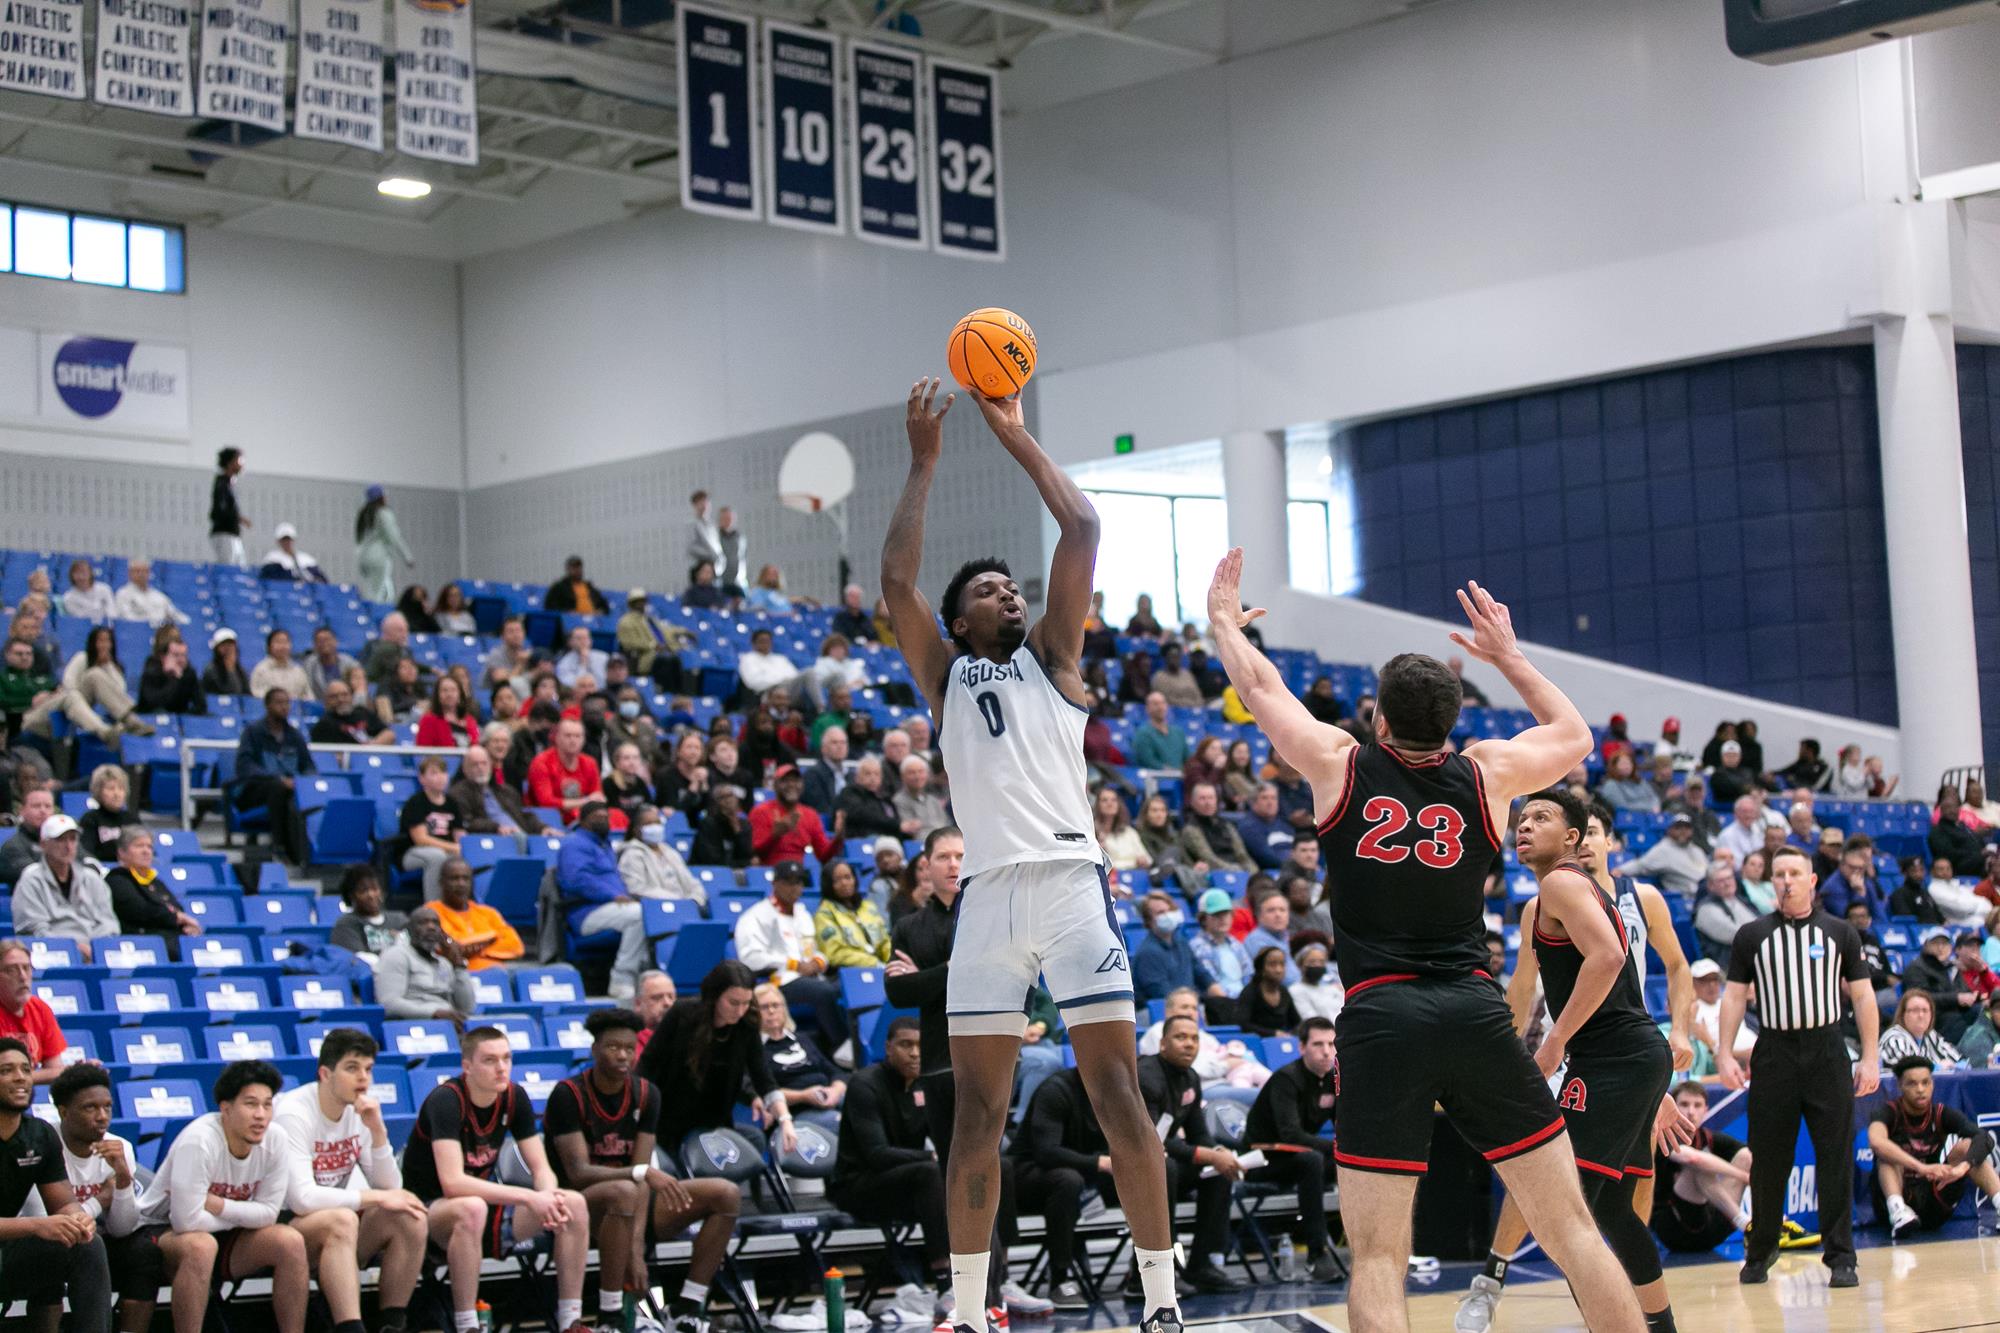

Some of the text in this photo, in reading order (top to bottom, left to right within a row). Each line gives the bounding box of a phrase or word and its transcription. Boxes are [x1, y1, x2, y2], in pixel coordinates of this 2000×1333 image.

[6, 2, 72, 33] ATHLETIC
[115, 24, 178, 54] ATHLETIC
[102, 49, 184, 82] CONFERENC
[709, 92, 730, 149] 1
[781, 106, 829, 166] 10
[861, 123, 917, 183] 23
[940, 139, 994, 197] 32
[1003, 341, 1031, 377] NCAA
[976, 691, 1006, 738] 0
[1356, 796, 1468, 869] 23
[1560, 1076, 1587, 1112] A
